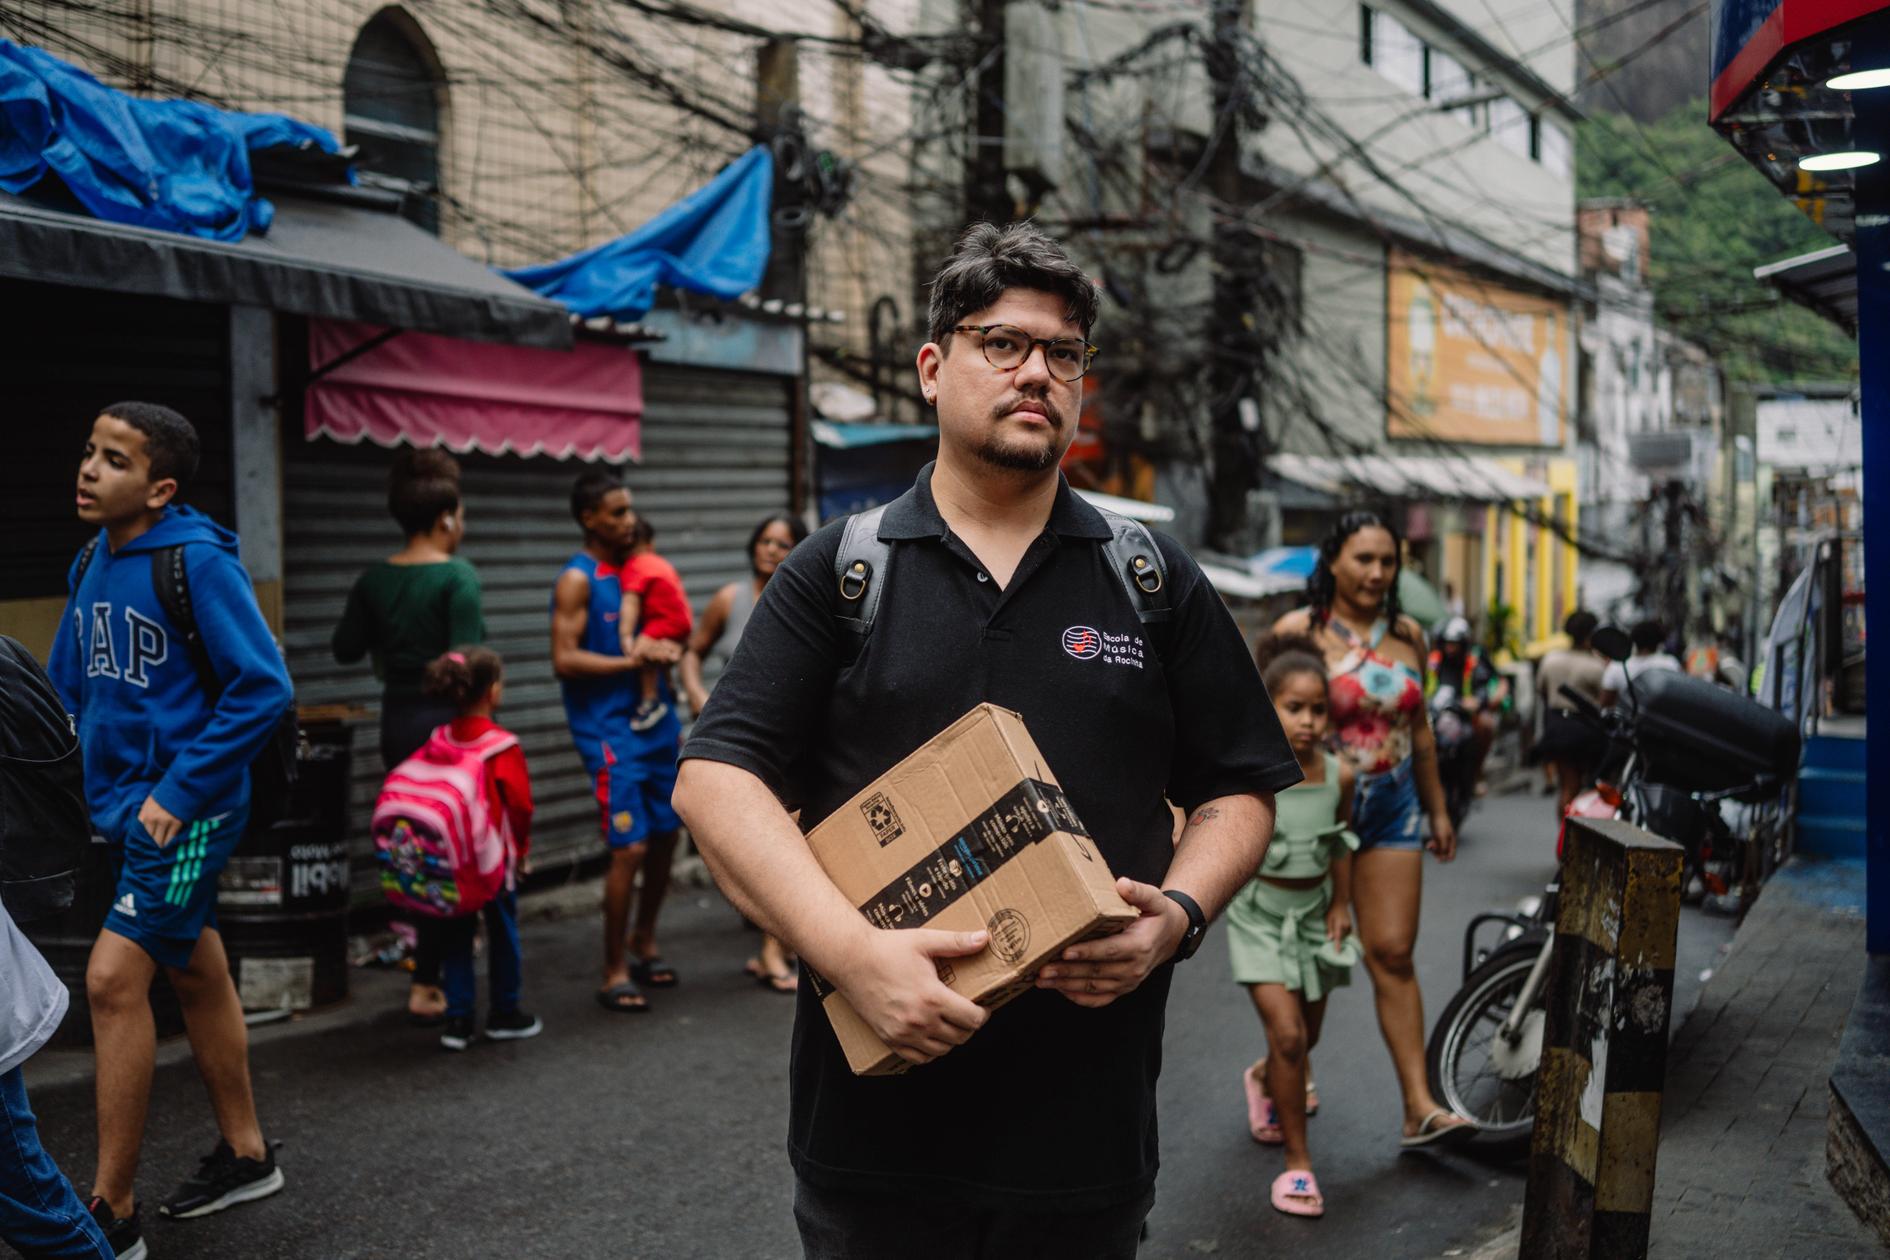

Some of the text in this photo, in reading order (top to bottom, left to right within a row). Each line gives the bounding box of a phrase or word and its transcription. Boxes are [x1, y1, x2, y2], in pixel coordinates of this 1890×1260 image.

[1102, 631, 1143, 647] Escola de
[1102, 642, 1145, 659] Música
[1102, 654, 1144, 669] da Rocinha
